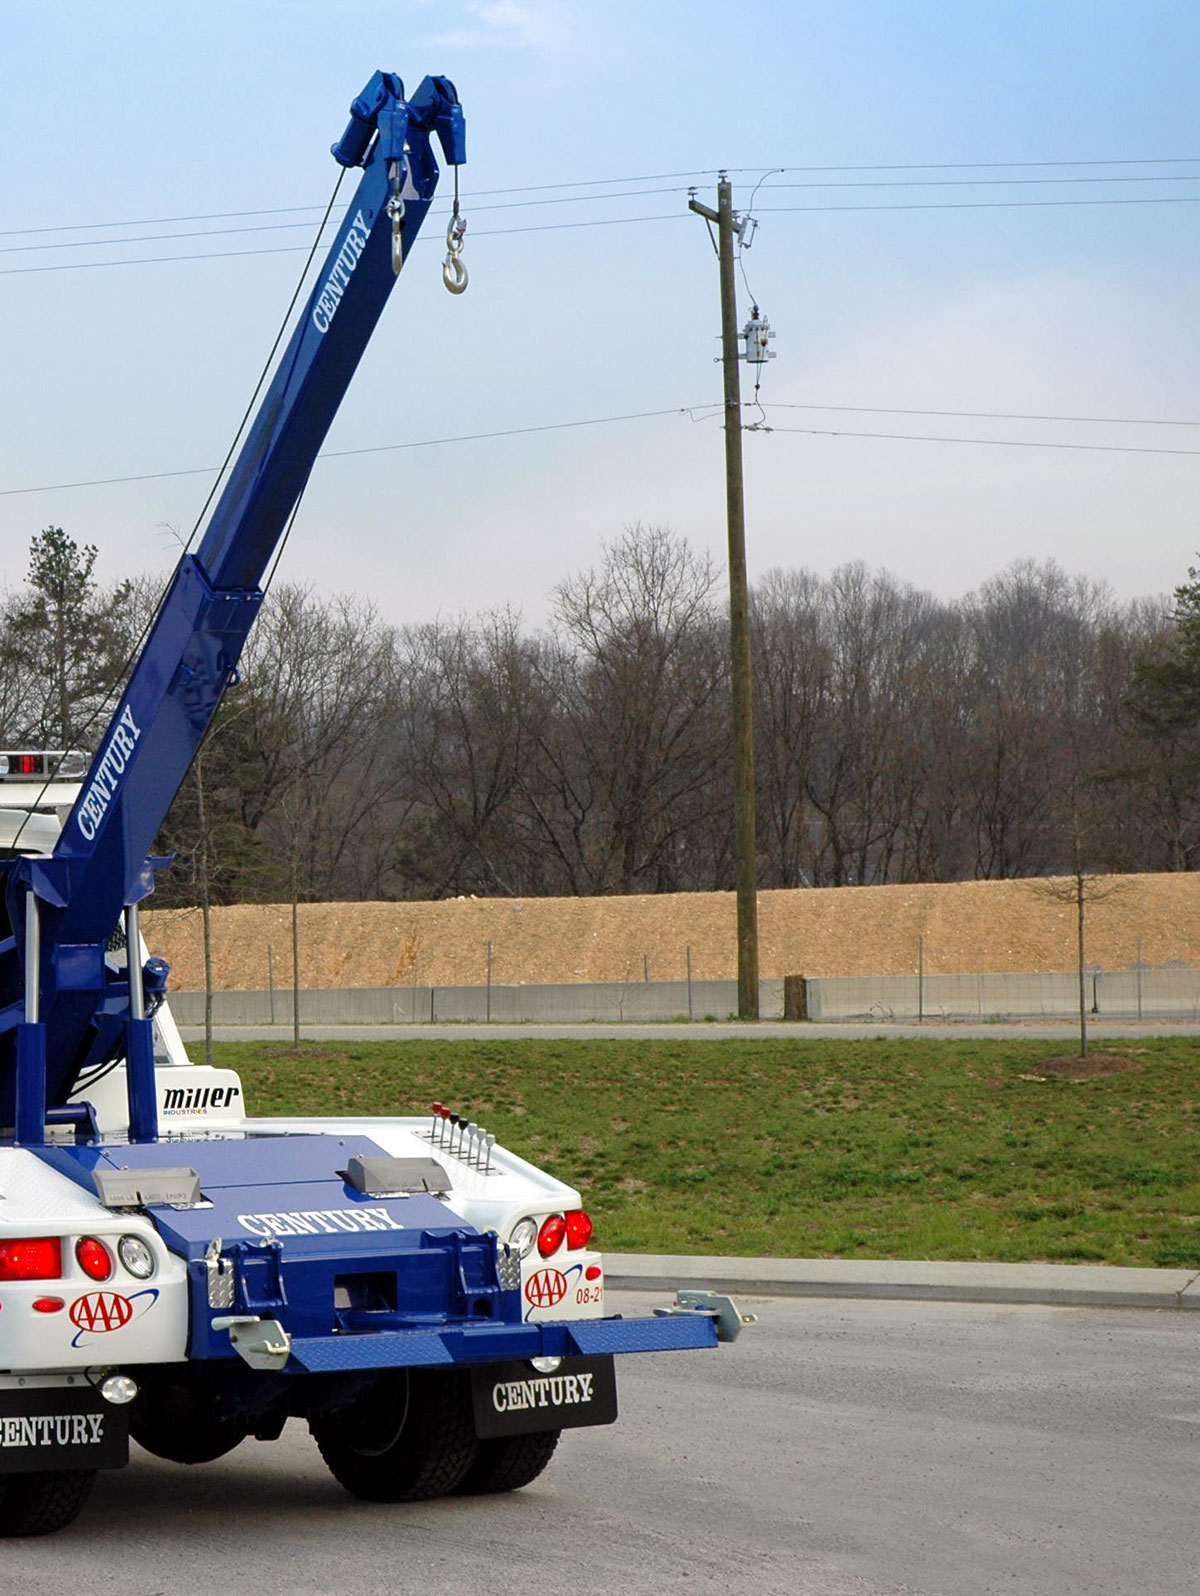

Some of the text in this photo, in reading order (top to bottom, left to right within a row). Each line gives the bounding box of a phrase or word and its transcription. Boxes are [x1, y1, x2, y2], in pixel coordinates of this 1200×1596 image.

[312, 209, 371, 334] CENTURY
[77, 704, 141, 841] CENTURY
[163, 1087, 239, 1109] miller
[237, 1207, 405, 1237] CENTURY
[525, 1268, 567, 1308] AAA
[69, 1291, 133, 1333] AAA
[492, 1373, 594, 1412] CENTURY
